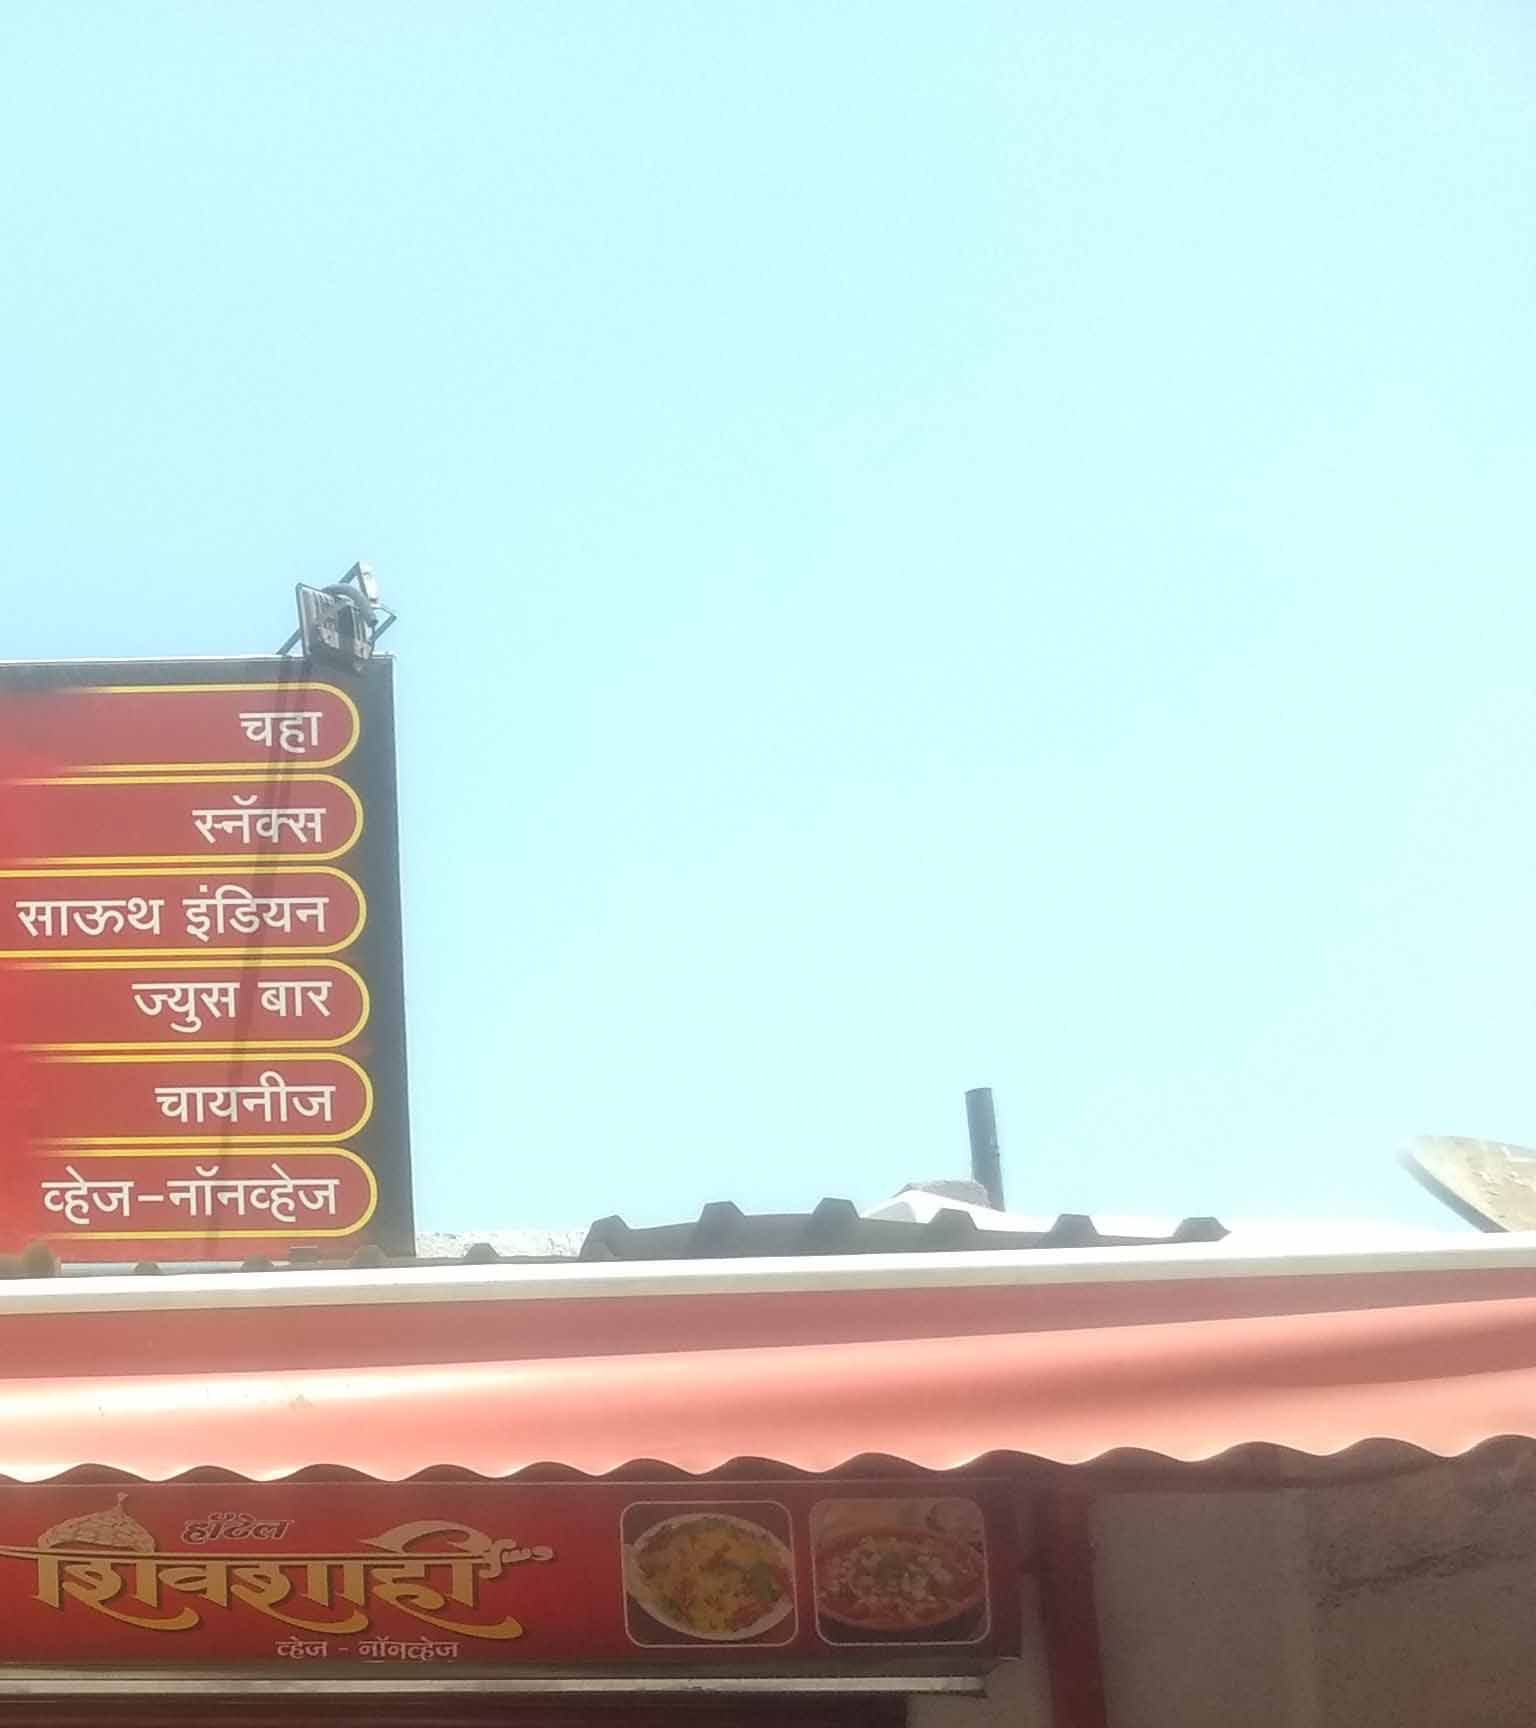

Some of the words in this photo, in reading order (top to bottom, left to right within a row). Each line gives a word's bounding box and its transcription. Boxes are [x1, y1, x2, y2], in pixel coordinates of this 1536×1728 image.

[239, 711, 323, 753] चहा
[192, 795, 326, 844] स्नॅक्स
[15, 897, 165, 938] साऊथ
[182, 885, 330, 942] इंडियन
[132, 981, 240, 1033] ज्युस
[258, 980, 333, 1018] बार
[155, 1072, 337, 1123] चायनीज
[180, 1511, 295, 1544] हॉटेल
